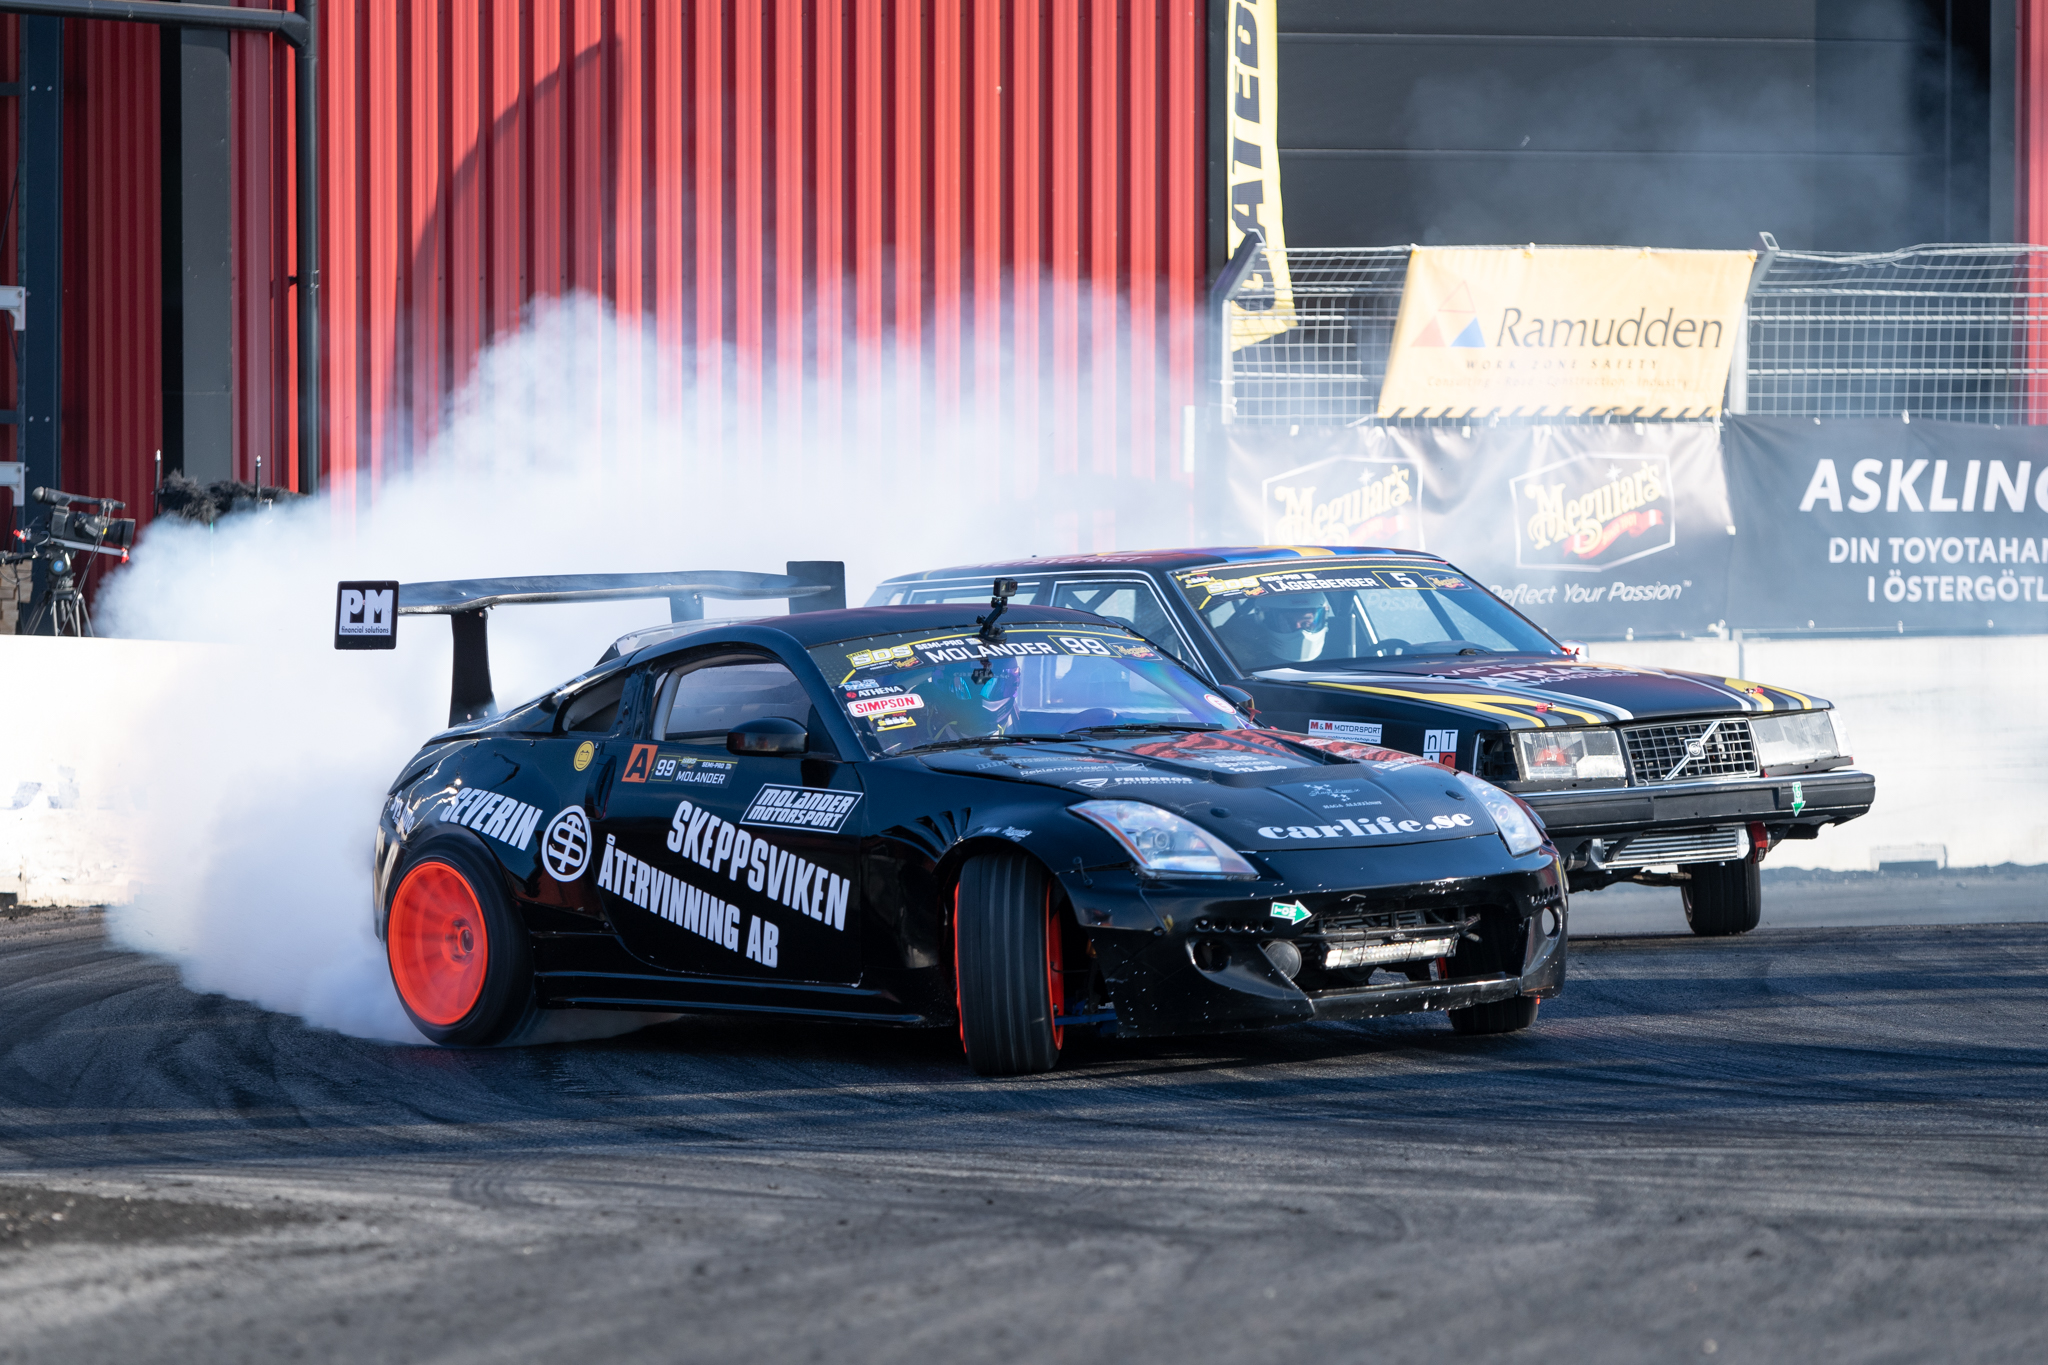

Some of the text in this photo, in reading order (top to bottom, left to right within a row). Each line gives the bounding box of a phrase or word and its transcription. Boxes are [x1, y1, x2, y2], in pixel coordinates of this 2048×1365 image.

[1496, 307, 1723, 348] Ramudden
[1524, 461, 1665, 555] Meguiar's
[1829, 537, 1880, 564] DIN
[1207, 577, 1260, 593] SDS
[1268, 577, 1380, 592] LÄGGEBERGER
[1389, 572, 1419, 588] 5
[1868, 569, 2048, 603] I ÖSTERGÖTL
[1365, 591, 1430, 612] Passio
[1488, 583, 1558, 607] Reflect
[1564, 583, 1607, 604] Your
[1607, 581, 1683, 602] Passion
[339, 589, 394, 624] PM
[341, 626, 389, 634] financial solutions
[853, 645, 913, 667] SDS
[914, 639, 965, 651] SEMI-PRO
[924, 641, 1058, 664] MOLANDER
[1059, 637, 1111, 656] 99
[858, 685, 903, 697] ATHENA
[855, 696, 915, 713] SIMPSON
[1334, 724, 1381, 734] MOTORSPORT
[655, 759, 726, 785] 99 MOLANDER
[701, 761, 725, 769] SEMI-PRO
[1020, 764, 1109, 777] Reklambolaget
[756, 788, 855, 814] MOLANDER
[1794, 784, 1802, 804] TOW
[439, 787, 543, 851] SEVERIN
[747, 805, 844, 828] MOTORSPORT
[1257, 813, 1475, 840] carlife.se
[666, 800, 850, 932] SKEPPSVIKEN
[597, 833, 779, 969] ÅTERVINNING AB
[1273, 905, 1298, 917] TOW
